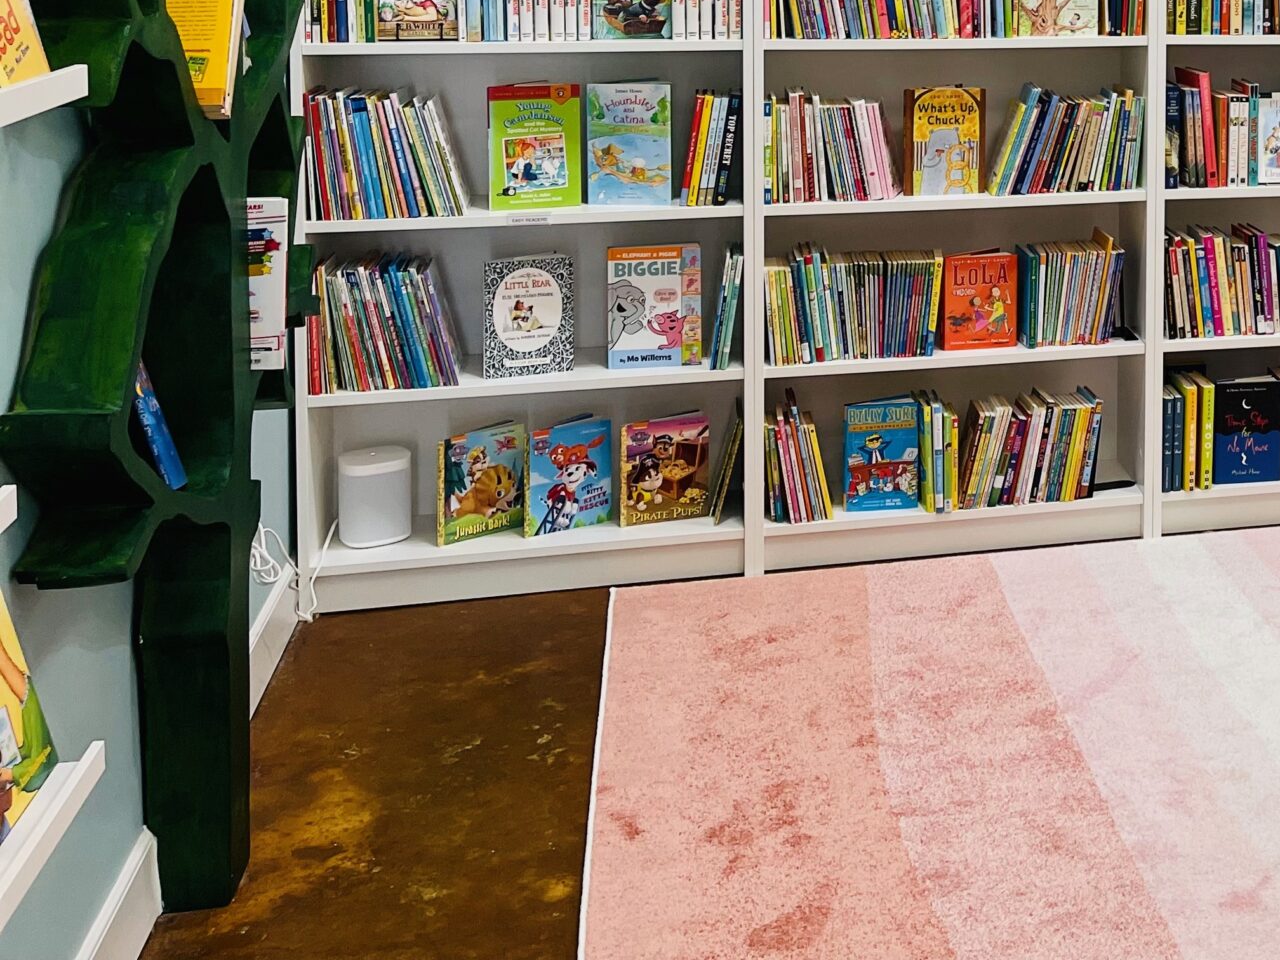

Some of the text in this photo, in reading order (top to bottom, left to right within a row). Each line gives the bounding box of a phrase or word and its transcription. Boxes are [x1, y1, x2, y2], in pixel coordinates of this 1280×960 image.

[517, 102, 550, 112] Young
[918, 102, 977, 115] What's Up,
[613, 114, 645, 124] Catina
[927, 115, 966, 125] Chuck?
[722, 115, 736, 166] TOP SECRET
[622, 251, 651, 259] ELEPHANT
[614, 257, 686, 278] BIGGIE!
[504, 280, 530, 290] LITTLE
[627, 354, 640, 363] Mo
[640, 353, 672, 362] Willems
[848, 406, 884, 425] BILLY
[1227, 437, 1240, 453] No
[583, 491, 608, 505] KITTY
[579, 498, 609, 512] RESCUE
[631, 510, 669, 523] PIRATE
[454, 514, 511, 540] Jurassic Bark!
